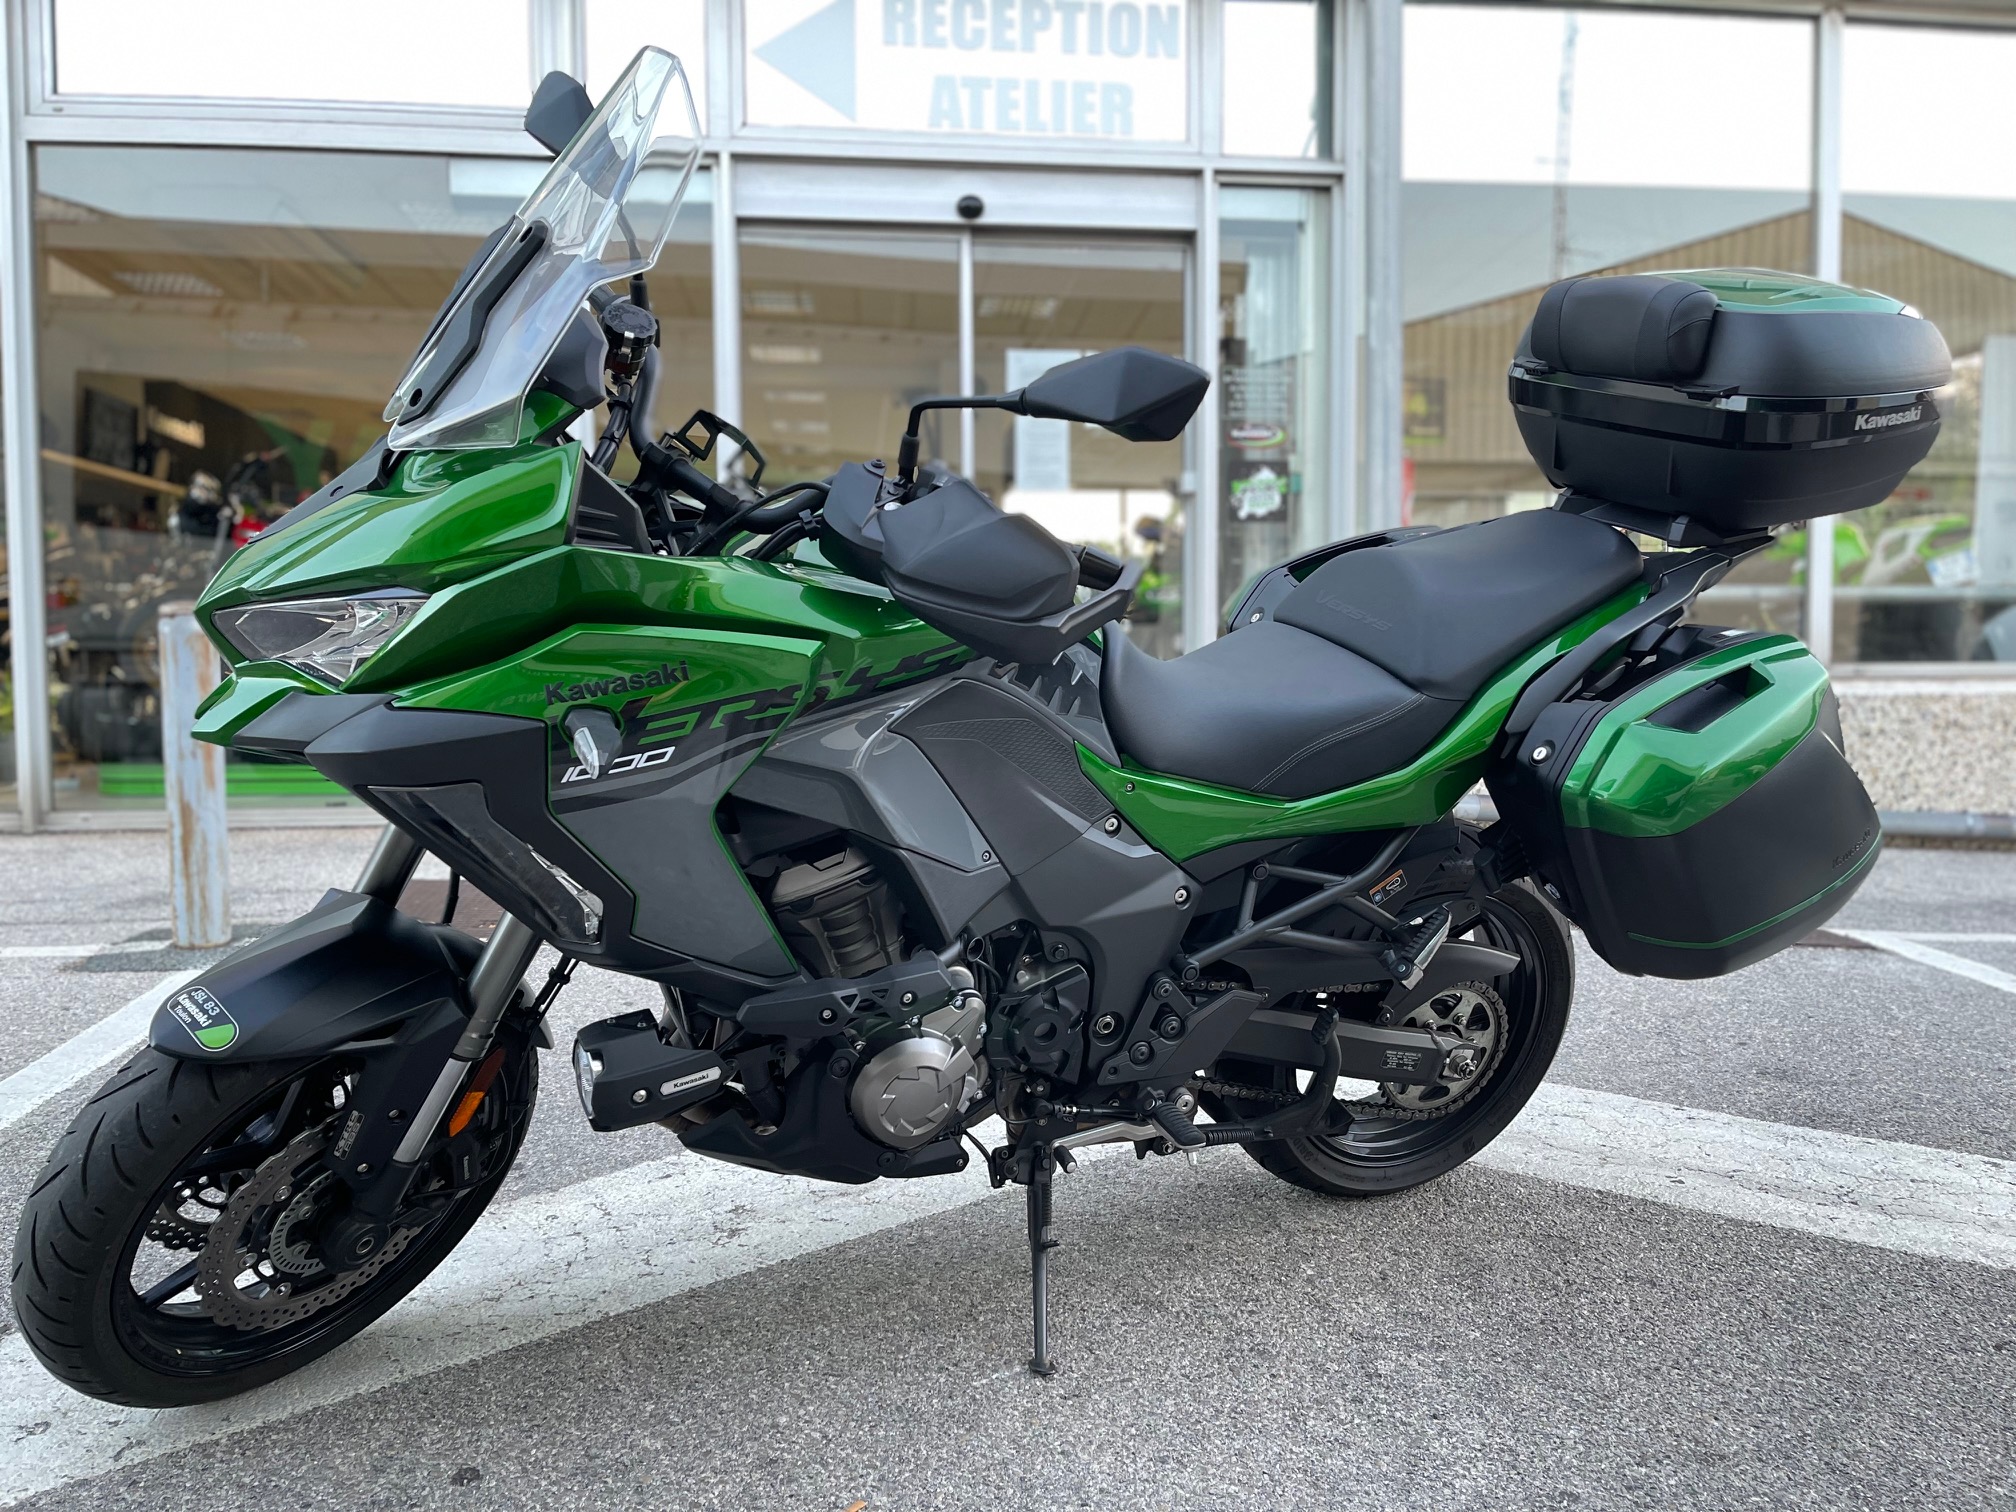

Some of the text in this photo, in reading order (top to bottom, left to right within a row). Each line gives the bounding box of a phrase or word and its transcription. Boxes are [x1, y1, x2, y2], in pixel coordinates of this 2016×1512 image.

[882, 0, 1181, 59] RECEPTION
[928, 75, 1134, 136] ATELIER
[1854, 405, 1922, 431] Kawasaki
[543, 660, 691, 705] Kawasaki
[173, 1005, 193, 1024] Toulon
[177, 993, 212, 1028] Kawasaki
[190, 989, 221, 1016] JSL 83
[673, 1073, 710, 1090] Kawasaki
